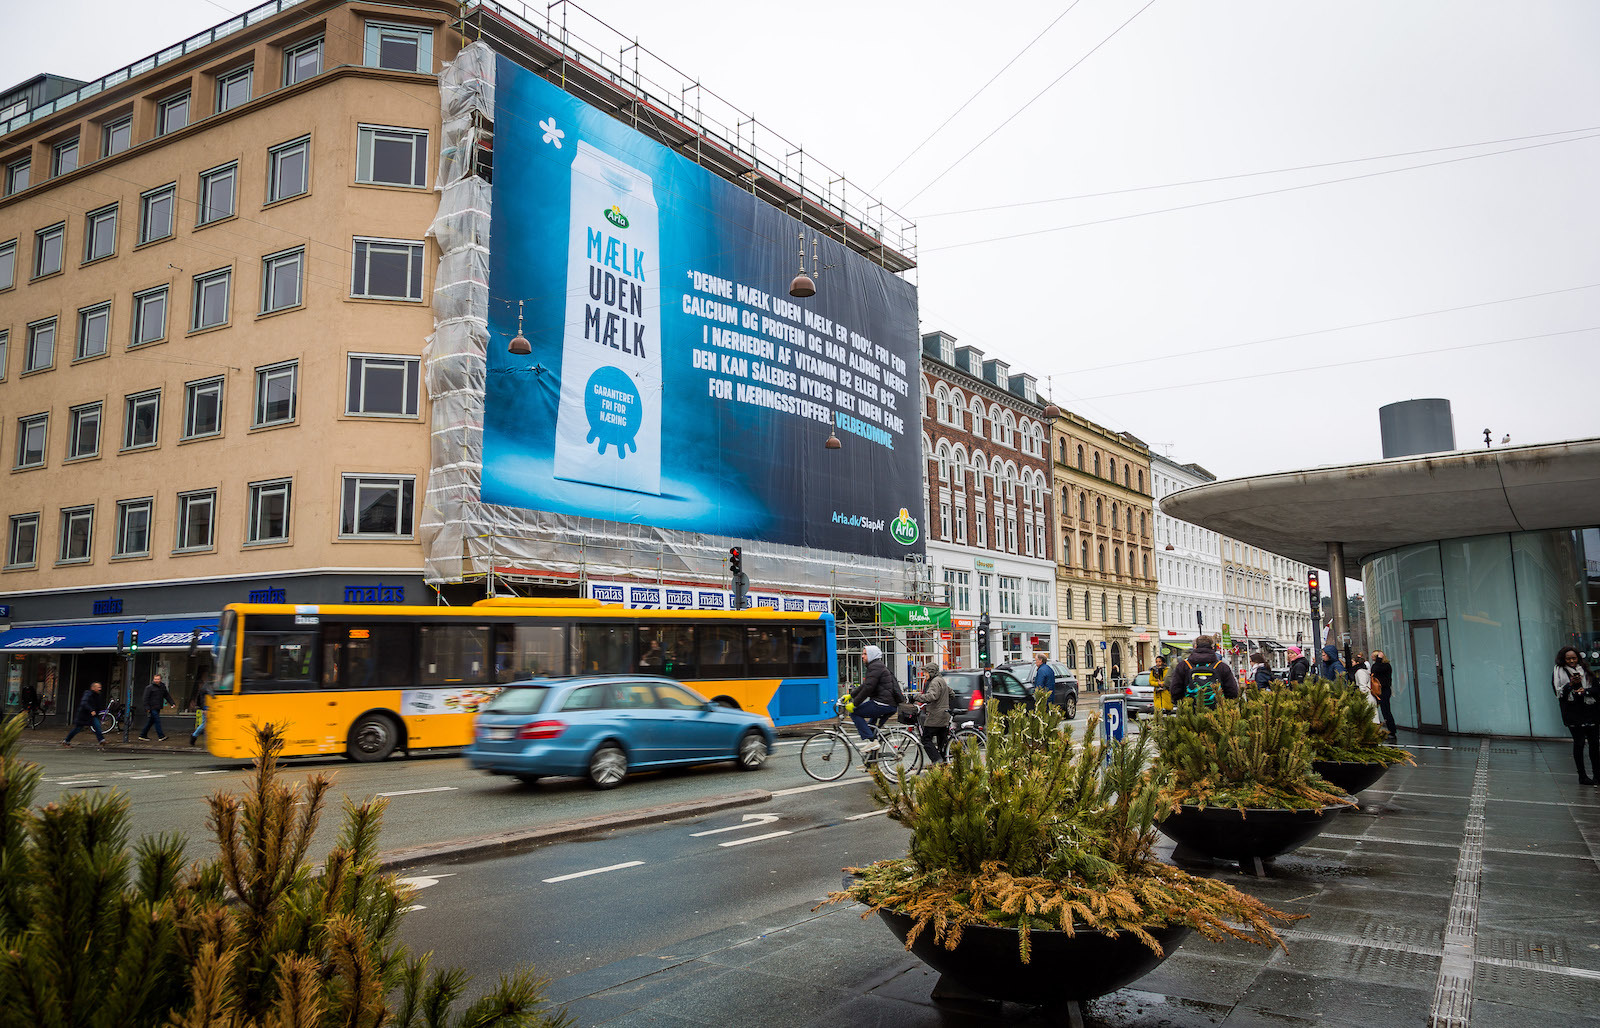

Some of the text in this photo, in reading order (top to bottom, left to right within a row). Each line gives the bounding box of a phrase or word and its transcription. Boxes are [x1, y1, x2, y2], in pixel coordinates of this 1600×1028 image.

[606, 210, 627, 226] Arla
[587, 226, 646, 283] MÆLK
[589, 264, 642, 318] UDEN
[584, 303, 646, 359] MÆLK
[737, 283, 770, 312] MÆLK
[773, 297, 801, 322] UDEN
[804, 309, 833, 337] MÆLK
[836, 323, 848, 344] ER
[850, 331, 873, 356] 100%
[875, 344, 889, 366] FRI
[891, 356, 907, 376] FOR
[682, 294, 909, 397] CALCIUM OG PROTEIN OG HAR ALDRIG VÆRET
[703, 325, 897, 411] I NÆRHEDEN AF VITAMIN B2 ELLER B12.
[594, 384, 635, 405] GARANTERET
[692, 349, 904, 435] DEN KAN SÅLEDES NYDES HELT UDEN FARE
[602, 399, 626, 415] FRI FOR
[709, 378, 733, 400] FOR
[835, 411, 895, 451] VELBEKOMME.
[600, 411, 627, 427] NÆRING
[831, 511, 885, 533] Arla.dk/SlapAf
[895, 522, 914, 537] Arla
[248, 586, 286, 604] matas
[344, 582, 405, 602] matas
[594, 587, 623, 600] matas
[632, 589, 659, 603] matas
[667, 591, 692, 604] matas
[700, 594, 723, 606] matas
[92, 597, 124, 615] matas
[758, 597, 779, 609] matas
[784, 599, 804, 611] matas
[809, 601, 828, 612] matas
[1109, 708, 1120, 743] P
